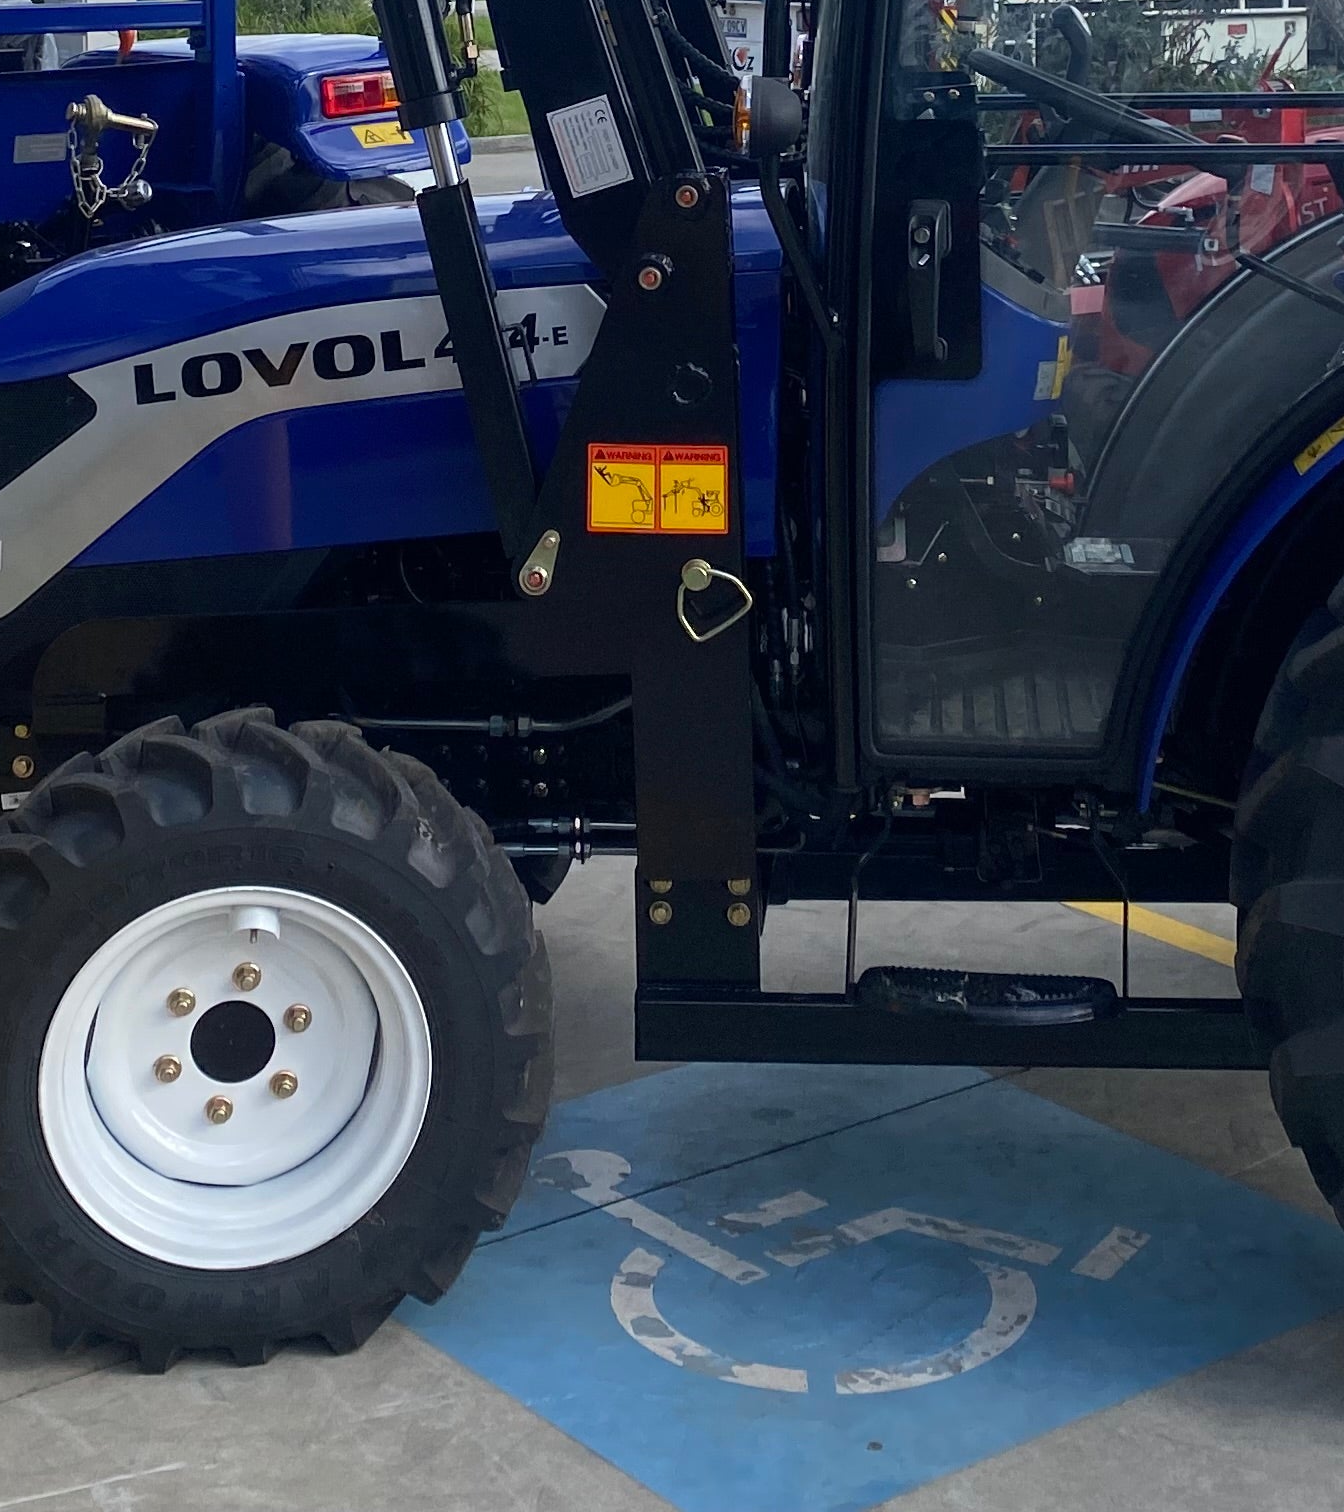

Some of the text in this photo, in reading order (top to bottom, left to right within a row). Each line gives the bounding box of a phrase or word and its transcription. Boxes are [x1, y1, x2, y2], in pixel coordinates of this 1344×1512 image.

[134, 330, 426, 406] LOVOL
[606, 450, 653, 461] WARNING
[674, 453, 721, 462] WARNING
